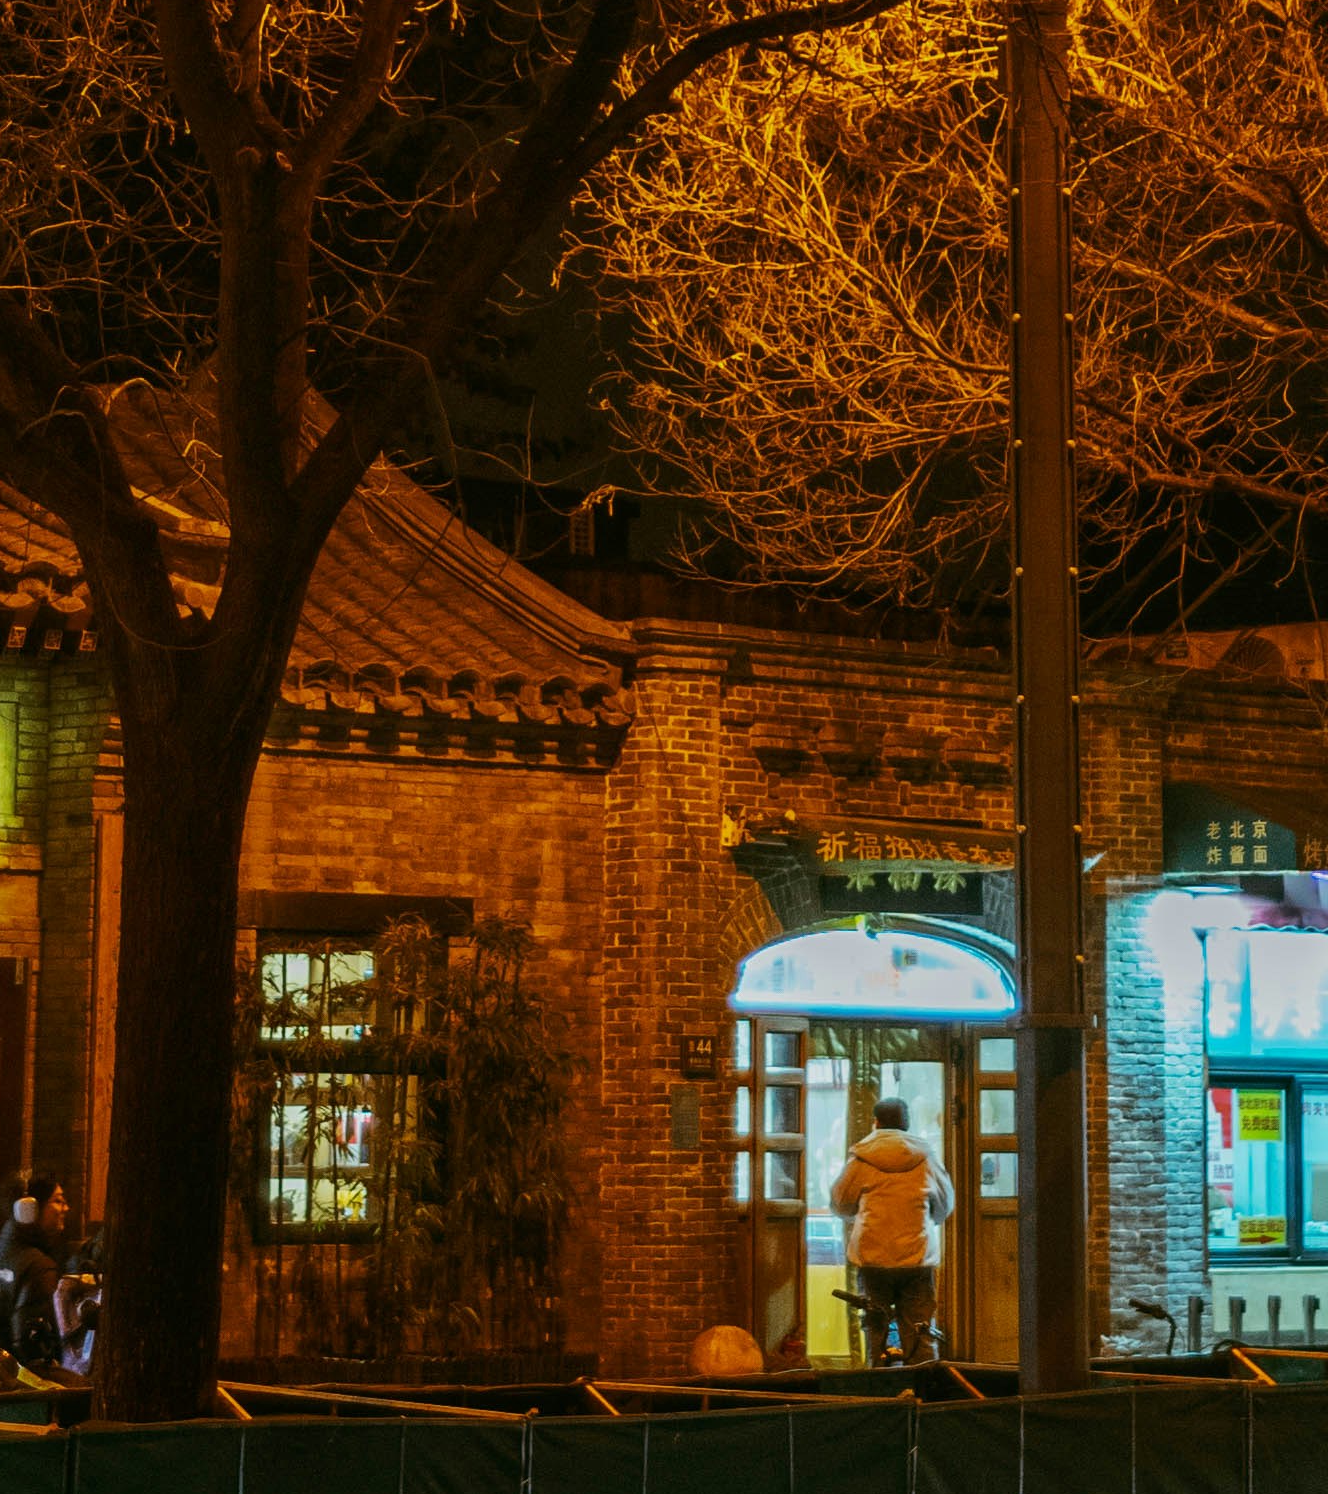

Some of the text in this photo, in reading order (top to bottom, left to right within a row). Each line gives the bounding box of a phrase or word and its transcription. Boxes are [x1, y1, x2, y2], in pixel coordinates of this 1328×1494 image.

[1207, 818, 1268, 839] 老北京
[1206, 843, 1269, 865] 炸酱面
[697, 1039, 712, 1054] 44
